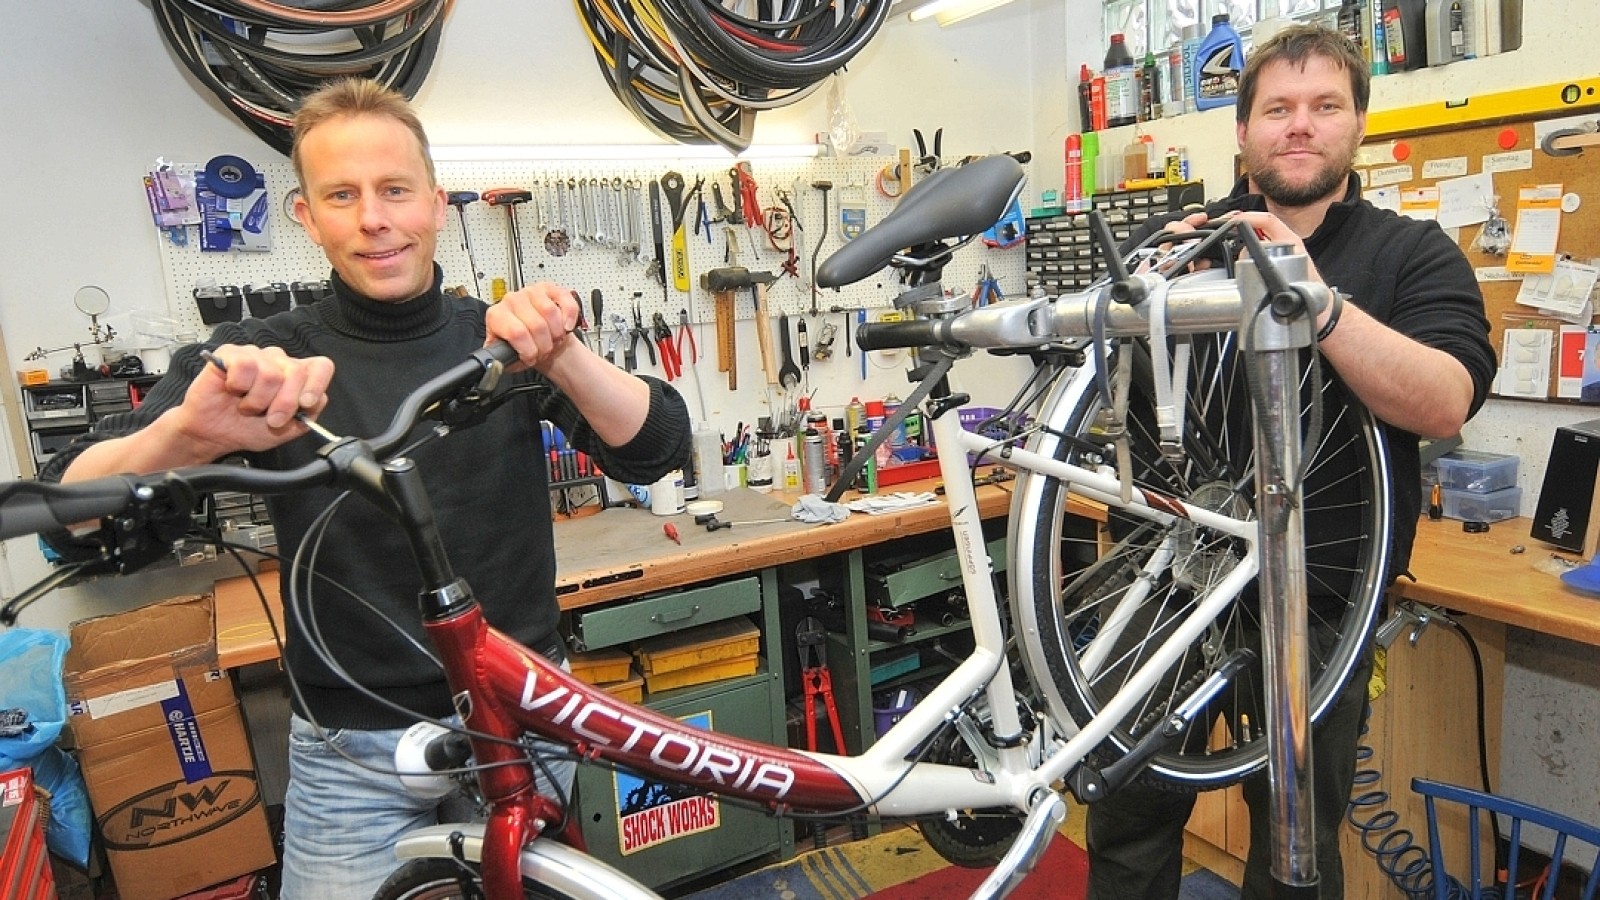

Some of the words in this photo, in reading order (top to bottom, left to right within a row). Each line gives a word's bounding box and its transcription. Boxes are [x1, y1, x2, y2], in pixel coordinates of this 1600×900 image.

[174, 722, 197, 763] HARTJE
[519, 670, 795, 798] VICTORIA
[126, 799, 242, 841] NORTHWAVE
[130, 780, 231, 829] NW
[623, 812, 666, 851] SHOCK
[668, 796, 716, 835] WORKS
